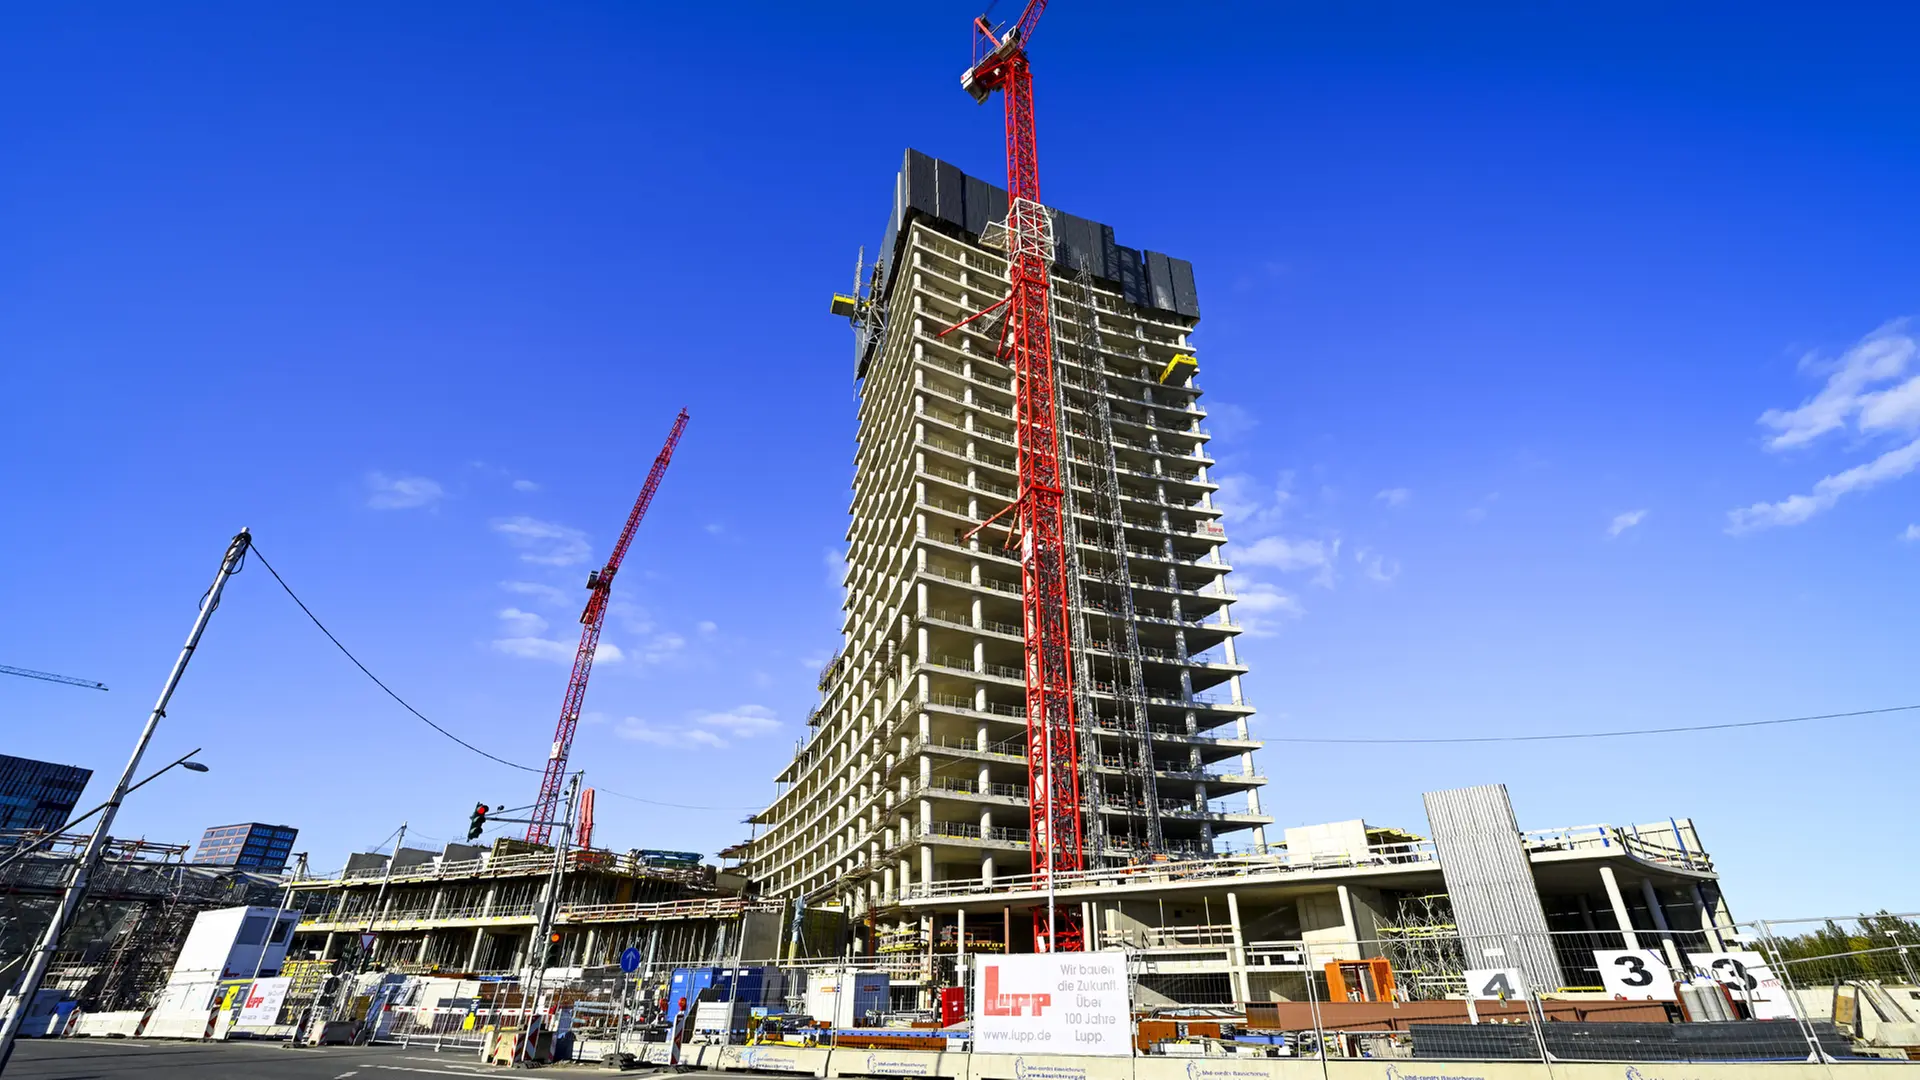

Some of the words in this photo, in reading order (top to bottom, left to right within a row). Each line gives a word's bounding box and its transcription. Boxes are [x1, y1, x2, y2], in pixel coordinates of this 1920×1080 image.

[1060, 964, 1077, 975] Wir
[1079, 964, 1115, 975] bauen
[1614, 956, 1654, 986] 3
[1712, 958, 1758, 991] 3
[1057, 980, 1075, 991] die
[1076, 979, 1120, 992] Zukunft.
[1482, 973, 1517, 998] 4
[1076, 994, 1102, 1008] Über
[1065, 1013, 1082, 1025] 100
[1084, 1012, 1117, 1025] Jahre
[983, 1029, 1052, 1043] www.lupp.de
[1075, 1030, 1106, 1044] Lupp.
